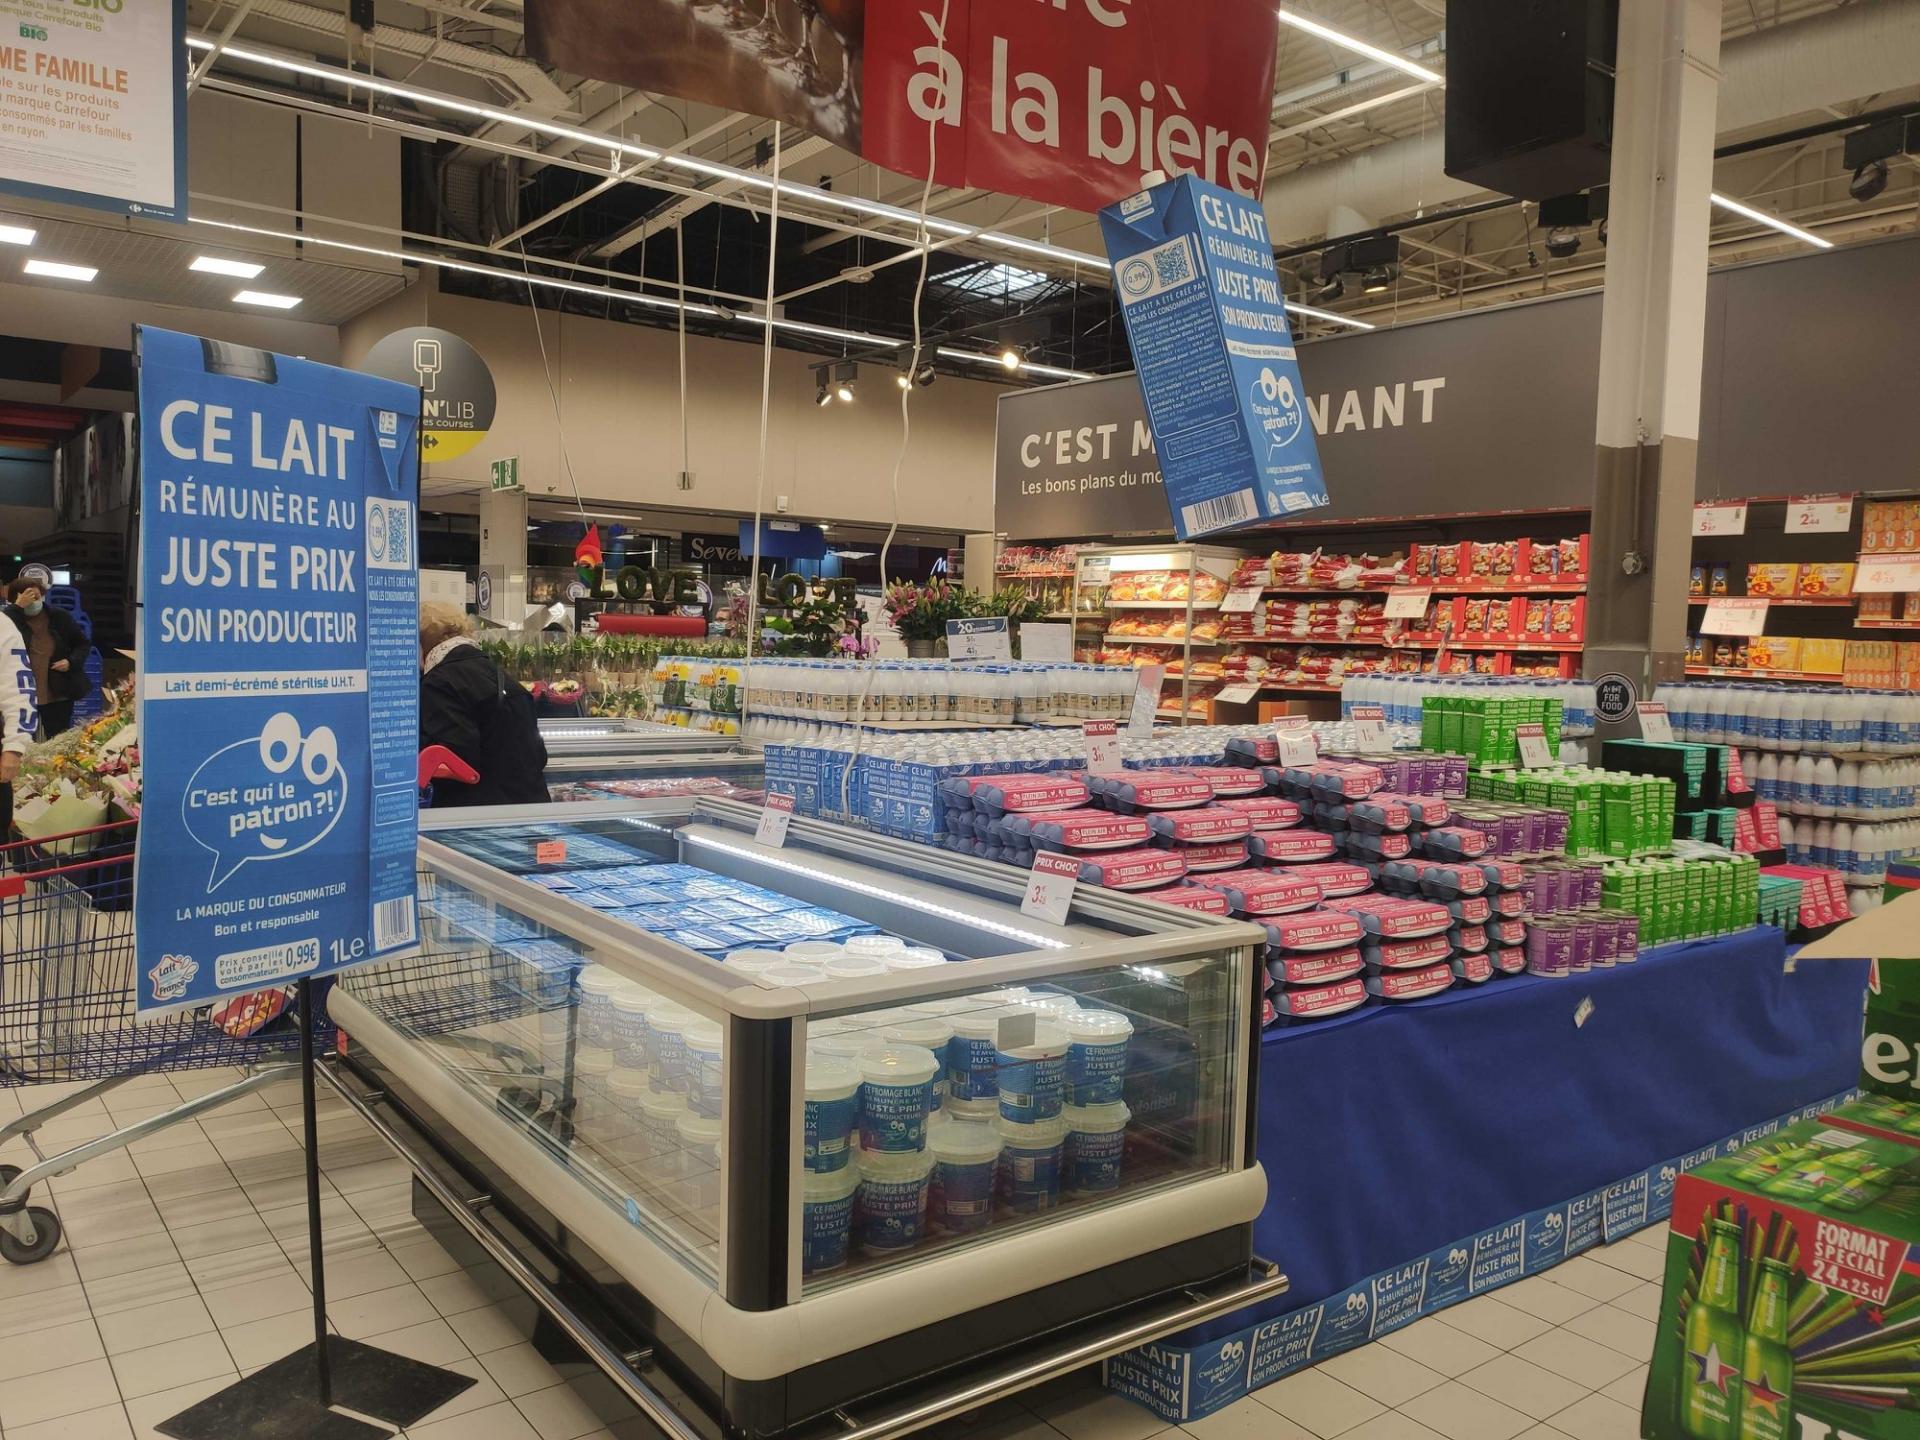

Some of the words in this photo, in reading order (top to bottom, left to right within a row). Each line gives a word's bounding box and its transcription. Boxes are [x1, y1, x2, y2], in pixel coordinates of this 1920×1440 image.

[35, 52, 128, 94] FAMILLE
[7, 95, 50, 111] marque
[55, 101, 110, 122] Carrefour
[17, 82, 39, 93] sur
[43, 83, 61, 97] les
[66, 89, 119, 110] produits
[906, 10, 963, 128] à
[991, 37, 1060, 149] la
[1087, 65, 1259, 205] bière
[60, 119, 75, 130] par
[79, 121, 91, 134] les
[95, 125, 132, 141] familles
[1200, 194, 1227, 230] CE
[1227, 203, 1265, 243] LAIT
[1208, 235, 1260, 268] RÉMUNÈRE
[1261, 253, 1273, 271] AU
[1193, 281, 1206, 293] PAR
[1216, 267, 1251, 301] JUSTE
[1253, 276, 1281, 305] PRIX
[1222, 304, 1236, 326] SON
[1236, 308, 1287, 333] PRODUCTEUR
[436, 418, 474, 429] courses
[160, 399, 233, 465] CE
[251, 411, 355, 480] LAIT
[1020, 422, 1118, 469] C'EST
[1021, 479, 1041, 496] Les
[1045, 476, 1076, 495] bons
[1080, 473, 1116, 493] plans
[1119, 470, 1136, 487] du
[160, 475, 319, 526] RÉMUNÈRE
[326, 500, 356, 530] AU
[160, 536, 277, 589] JUSTE
[290, 545, 356, 593] PRIX
[160, 607, 212, 643] SON
[218, 609, 357, 644] PRODUCTEUR
[165, 679, 192, 693] Lait
[195, 675, 279, 692] demi-écrémé
[282, 674, 329, 689] stérilisé
[331, 675, 355, 688] U.H.T.
[1601, 701, 1623, 711] FOOD
[1604, 693, 1620, 702] FOR
[1098, 723, 1115, 732] CHOC
[189, 787, 238, 808] C'est
[244, 783, 274, 805] qui
[279, 782, 295, 800] le
[1036, 856, 1053, 869] PRIX
[1055, 860, 1078, 873] CHOC
[176, 908, 192, 921] LA
[195, 899, 245, 920] MARQUE
[249, 897, 265, 911] DU
[268, 882, 347, 908] CONSOMMATEUR
[214, 923, 237, 937] Bon
[240, 919, 253, 932] et
[256, 909, 320, 931] responsable
[219, 957, 239, 969] Prix
[241, 949, 283, 965] conseillé
[220, 965, 244, 976] voté
[246, 963, 264, 975] par
[268, 958, 283, 970] les
[286, 942, 317, 968] 0,99€
[159, 963, 177, 978] Lait
[159, 978, 186, 996] France
[899, 1104, 921, 1112] PRIX
[1684, 1159, 1694, 1171] CE
[1694, 1148, 1713, 1167] LAIT
[1608, 1184, 1622, 1199] CE
[1623, 1176, 1645, 1194] LAIT
[1572, 1200, 1584, 1215] CE
[1608, 1209, 1627, 1225] JUSTE
[1480, 1234, 1494, 1250] CE
[1496, 1222, 1521, 1243] LAIT
[1511, 1240, 1520, 1248] AU
[1816, 1221, 1889, 1262] FORMAT
[1475, 1259, 1499, 1277] JUSTE
[1501, 1252, 1520, 1268] PRIX
[1815, 1241, 1886, 1278] SPECIAL
[1377, 1274, 1393, 1292] CE
[1396, 1261, 1425, 1285] LAIT
[1486, 1266, 1520, 1286] PRODUCTEUR
[1811, 1260, 1839, 1283] 24
[1840, 1279, 1849, 1290] x
[1849, 1279, 1869, 1296] 25
[1871, 1286, 1885, 1301] cl
[1376, 1301, 1401, 1321] JUSTE
[1402, 1291, 1420, 1308] PRIX
[1384, 1306, 1417, 1328] PRODUCTEUR
[1260, 1321, 1280, 1340] CE
[1283, 1308, 1318, 1331] LAIT
[1301, 1325, 1313, 1336] AU
[1140, 1345, 1181, 1370] LAIT
[1254, 1346, 1283, 1370] JUSTE
[1285, 1336, 1310, 1354] PRIX
[1166, 1373, 1180, 1385] AU
[1253, 1370, 1264, 1383] SON
[1265, 1350, 1305, 1377] PRODUCTEUR
[1112, 1361, 1148, 1388] JUSTE
[1152, 1379, 1180, 1403] PRIX
[1111, 1378, 1127, 1393] SON
[1129, 1385, 1179, 1419] PRODUCTEUR
